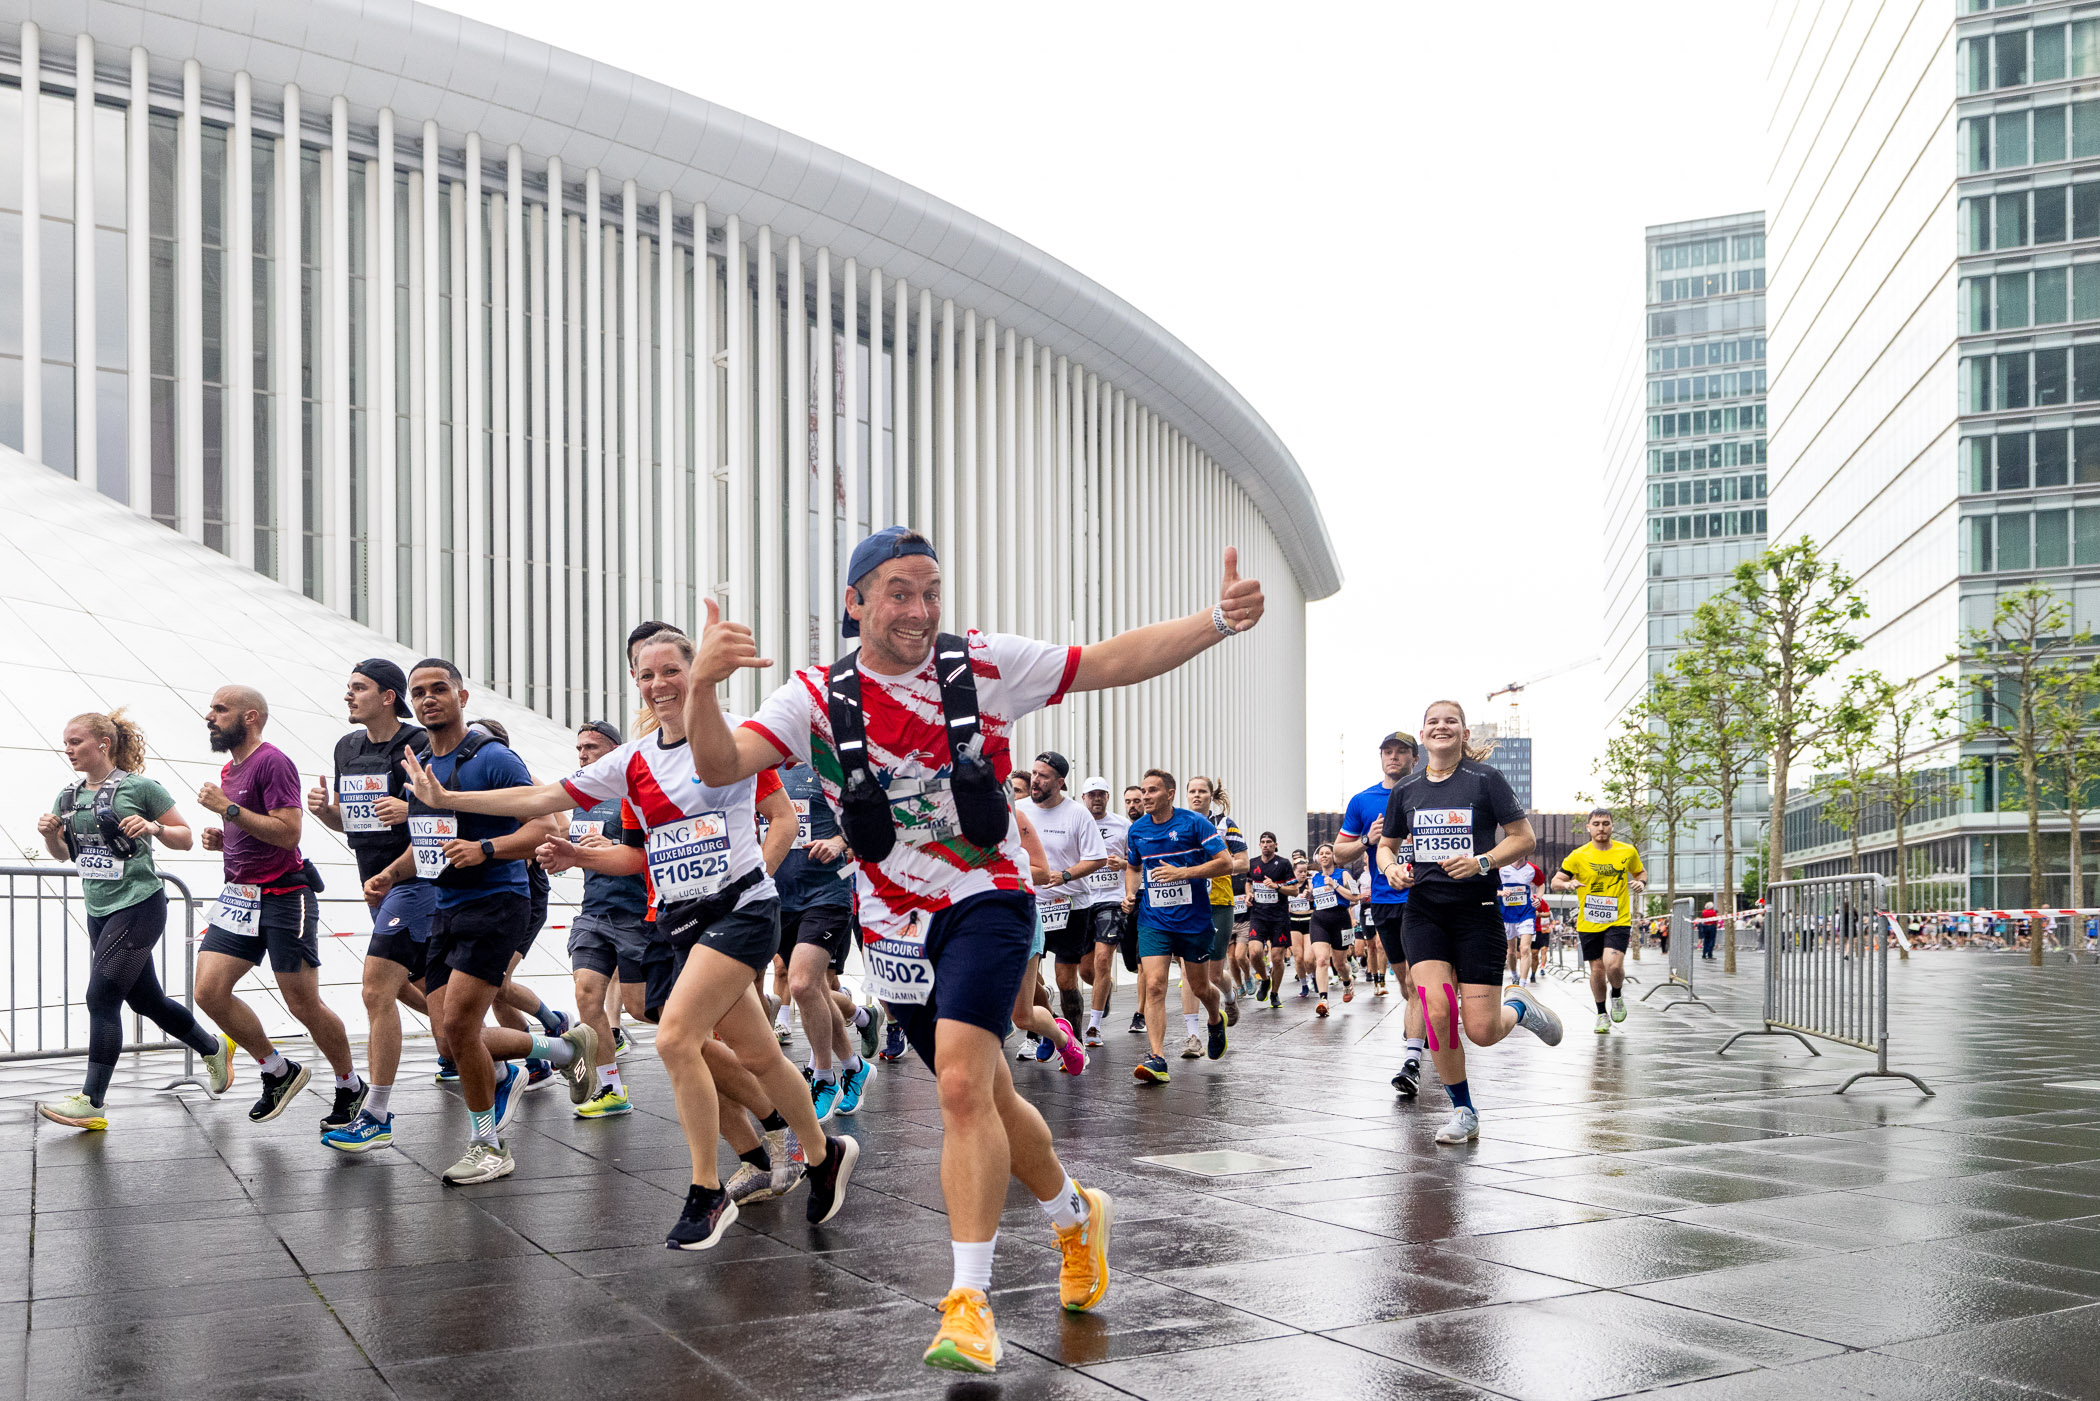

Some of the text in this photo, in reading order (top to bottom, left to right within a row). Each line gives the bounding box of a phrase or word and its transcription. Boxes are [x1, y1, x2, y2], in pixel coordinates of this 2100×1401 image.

[343, 780, 363, 791] ING
[343, 794, 384, 802] LUXEMBOURG
[1418, 813, 1444, 825] ING
[412, 821, 432, 834] ING
[571, 824, 587, 834] ING
[1417, 827, 1469, 835] LUXEMBOURG
[656, 826, 690, 849] ING
[1415, 837, 1471, 851] F13560
[418, 849, 446, 865] 9831
[654, 839, 724, 863] LUXEMBOURG
[80, 856, 114, 869] 9583
[653, 853, 729, 888] F10525
[1089, 873, 1119, 882] 11633
[678, 886, 709, 898] LUCILE
[1154, 887, 1184, 899] 7601
[1588, 897, 1603, 905] ING
[220, 906, 252, 924] 7124
[1041, 911, 1069, 924] 0177
[1588, 910, 1612, 919] 4508
[866, 940, 920, 957] XEMBOURG
[869, 953, 929, 984] 10502
[879, 987, 917, 1000] BENJAMIN
[360, 1124, 380, 1139] HOKA
